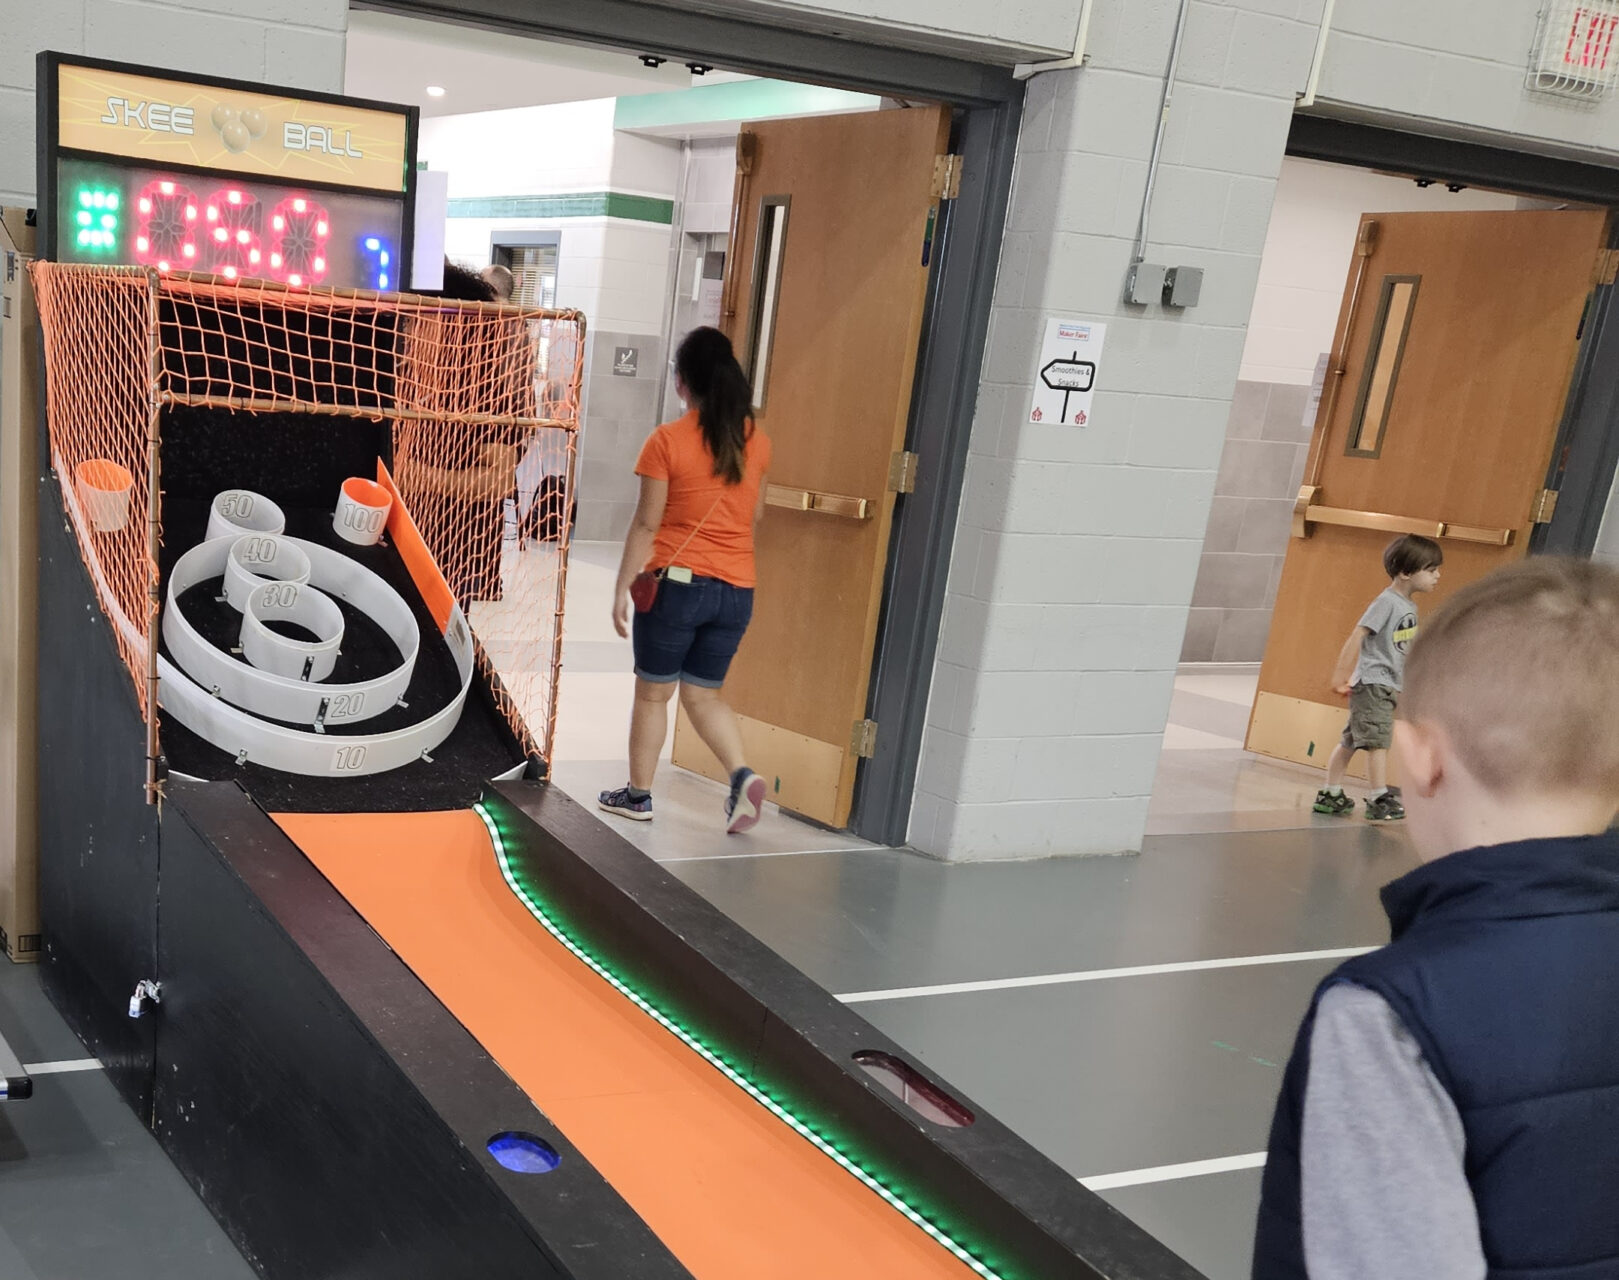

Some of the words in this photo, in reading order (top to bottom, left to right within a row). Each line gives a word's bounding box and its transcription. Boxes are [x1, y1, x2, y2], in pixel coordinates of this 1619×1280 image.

[101, 96, 195, 136] SKEE
[283, 121, 363, 158] BALL
[1051, 365, 1085, 376] Smoothies
[1058, 378, 1079, 387] Snacks
[221, 493, 254, 518] 50
[344, 503, 383, 533] 100
[243, 537, 277, 563] 40
[262, 584, 297, 608] 30
[331, 692, 365, 718] 20
[336, 745, 367, 770] 10
